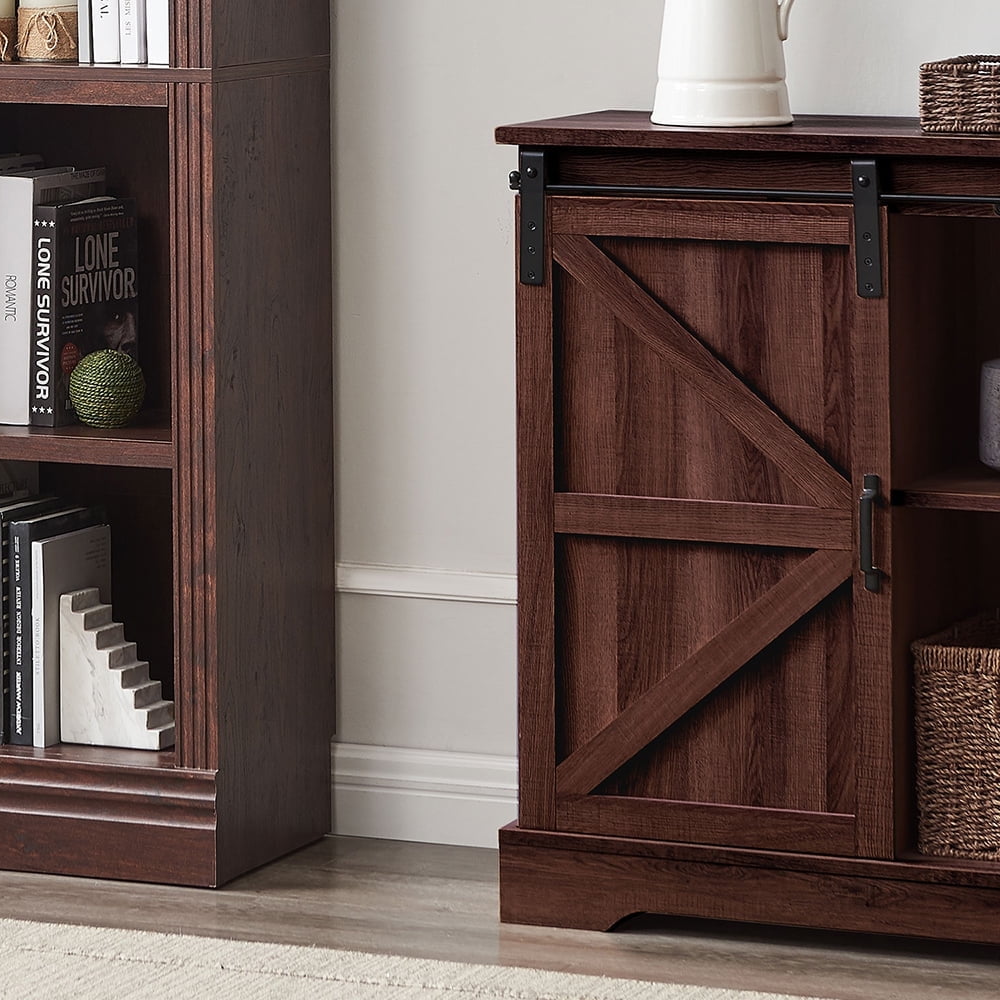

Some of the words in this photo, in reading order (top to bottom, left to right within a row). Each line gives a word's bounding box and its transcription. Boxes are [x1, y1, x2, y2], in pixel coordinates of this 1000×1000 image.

[37, 238, 51, 290] LONE
[75, 232, 119, 273] LONE
[5, 274, 17, 322] ROMANTIC
[61, 267, 137, 308] SURVIVOR
[36, 294, 50, 400] SURVIVOR
